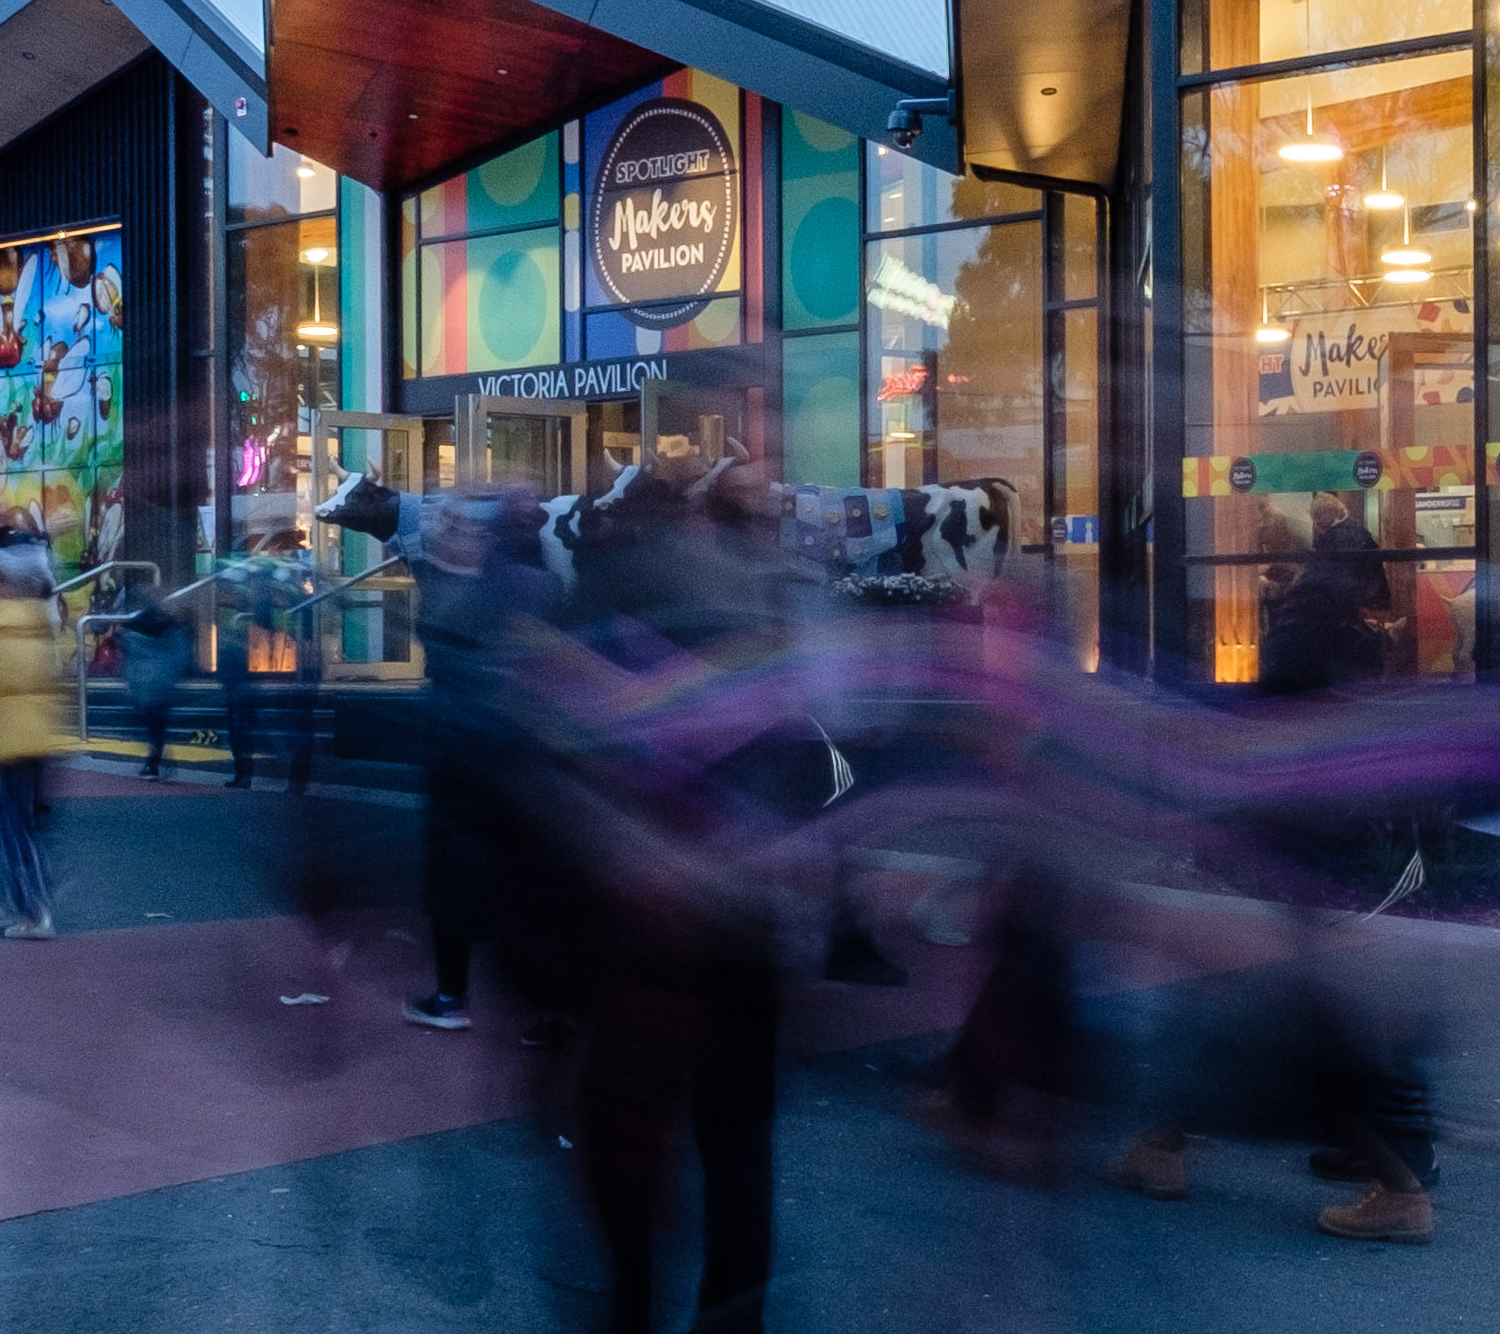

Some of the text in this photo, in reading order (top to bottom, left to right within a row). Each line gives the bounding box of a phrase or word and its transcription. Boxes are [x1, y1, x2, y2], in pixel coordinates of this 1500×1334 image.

[615, 149, 710, 184] SPOTLIGHT
[608, 188, 717, 251] Makers
[622, 242, 704, 274] PAVILION
[478, 359, 667, 399] VICTORIA PAVILION
